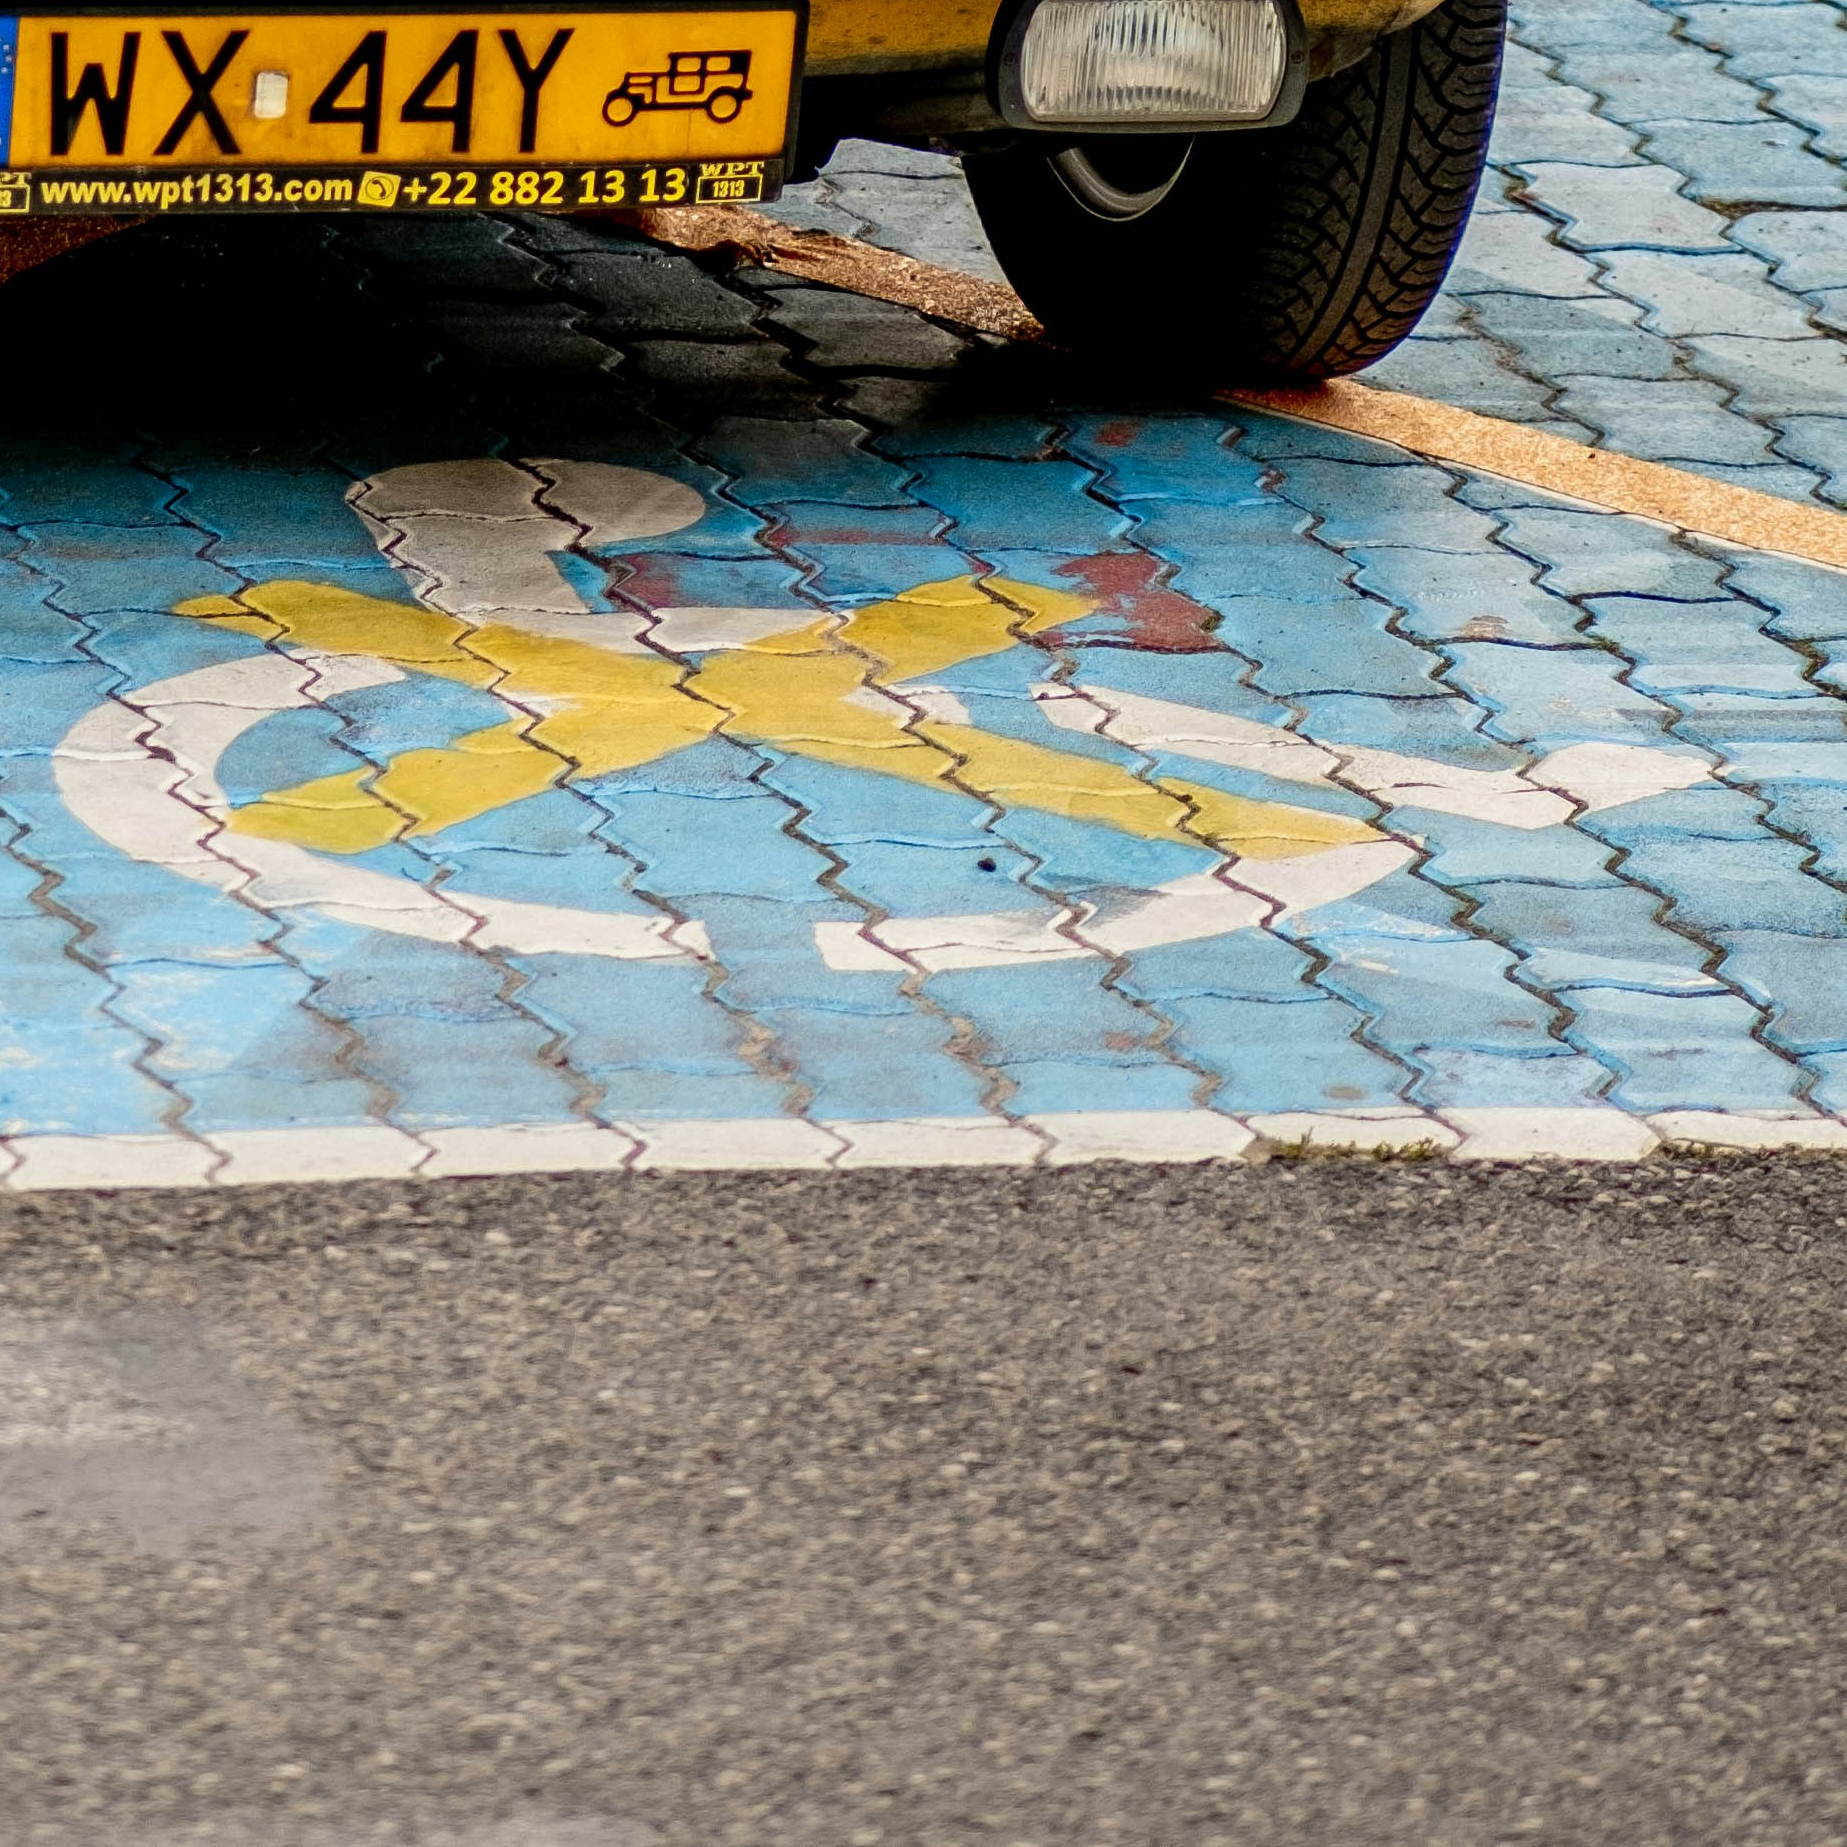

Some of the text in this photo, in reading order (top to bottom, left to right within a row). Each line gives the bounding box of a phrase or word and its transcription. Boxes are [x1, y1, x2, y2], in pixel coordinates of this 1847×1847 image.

[49, 28, 576, 157] WX 44Y
[698, 160, 766, 177] WPT
[40, 167, 687, 210] www.wpt1313.com +22 882 13 13
[712, 178, 746, 199] 1313
